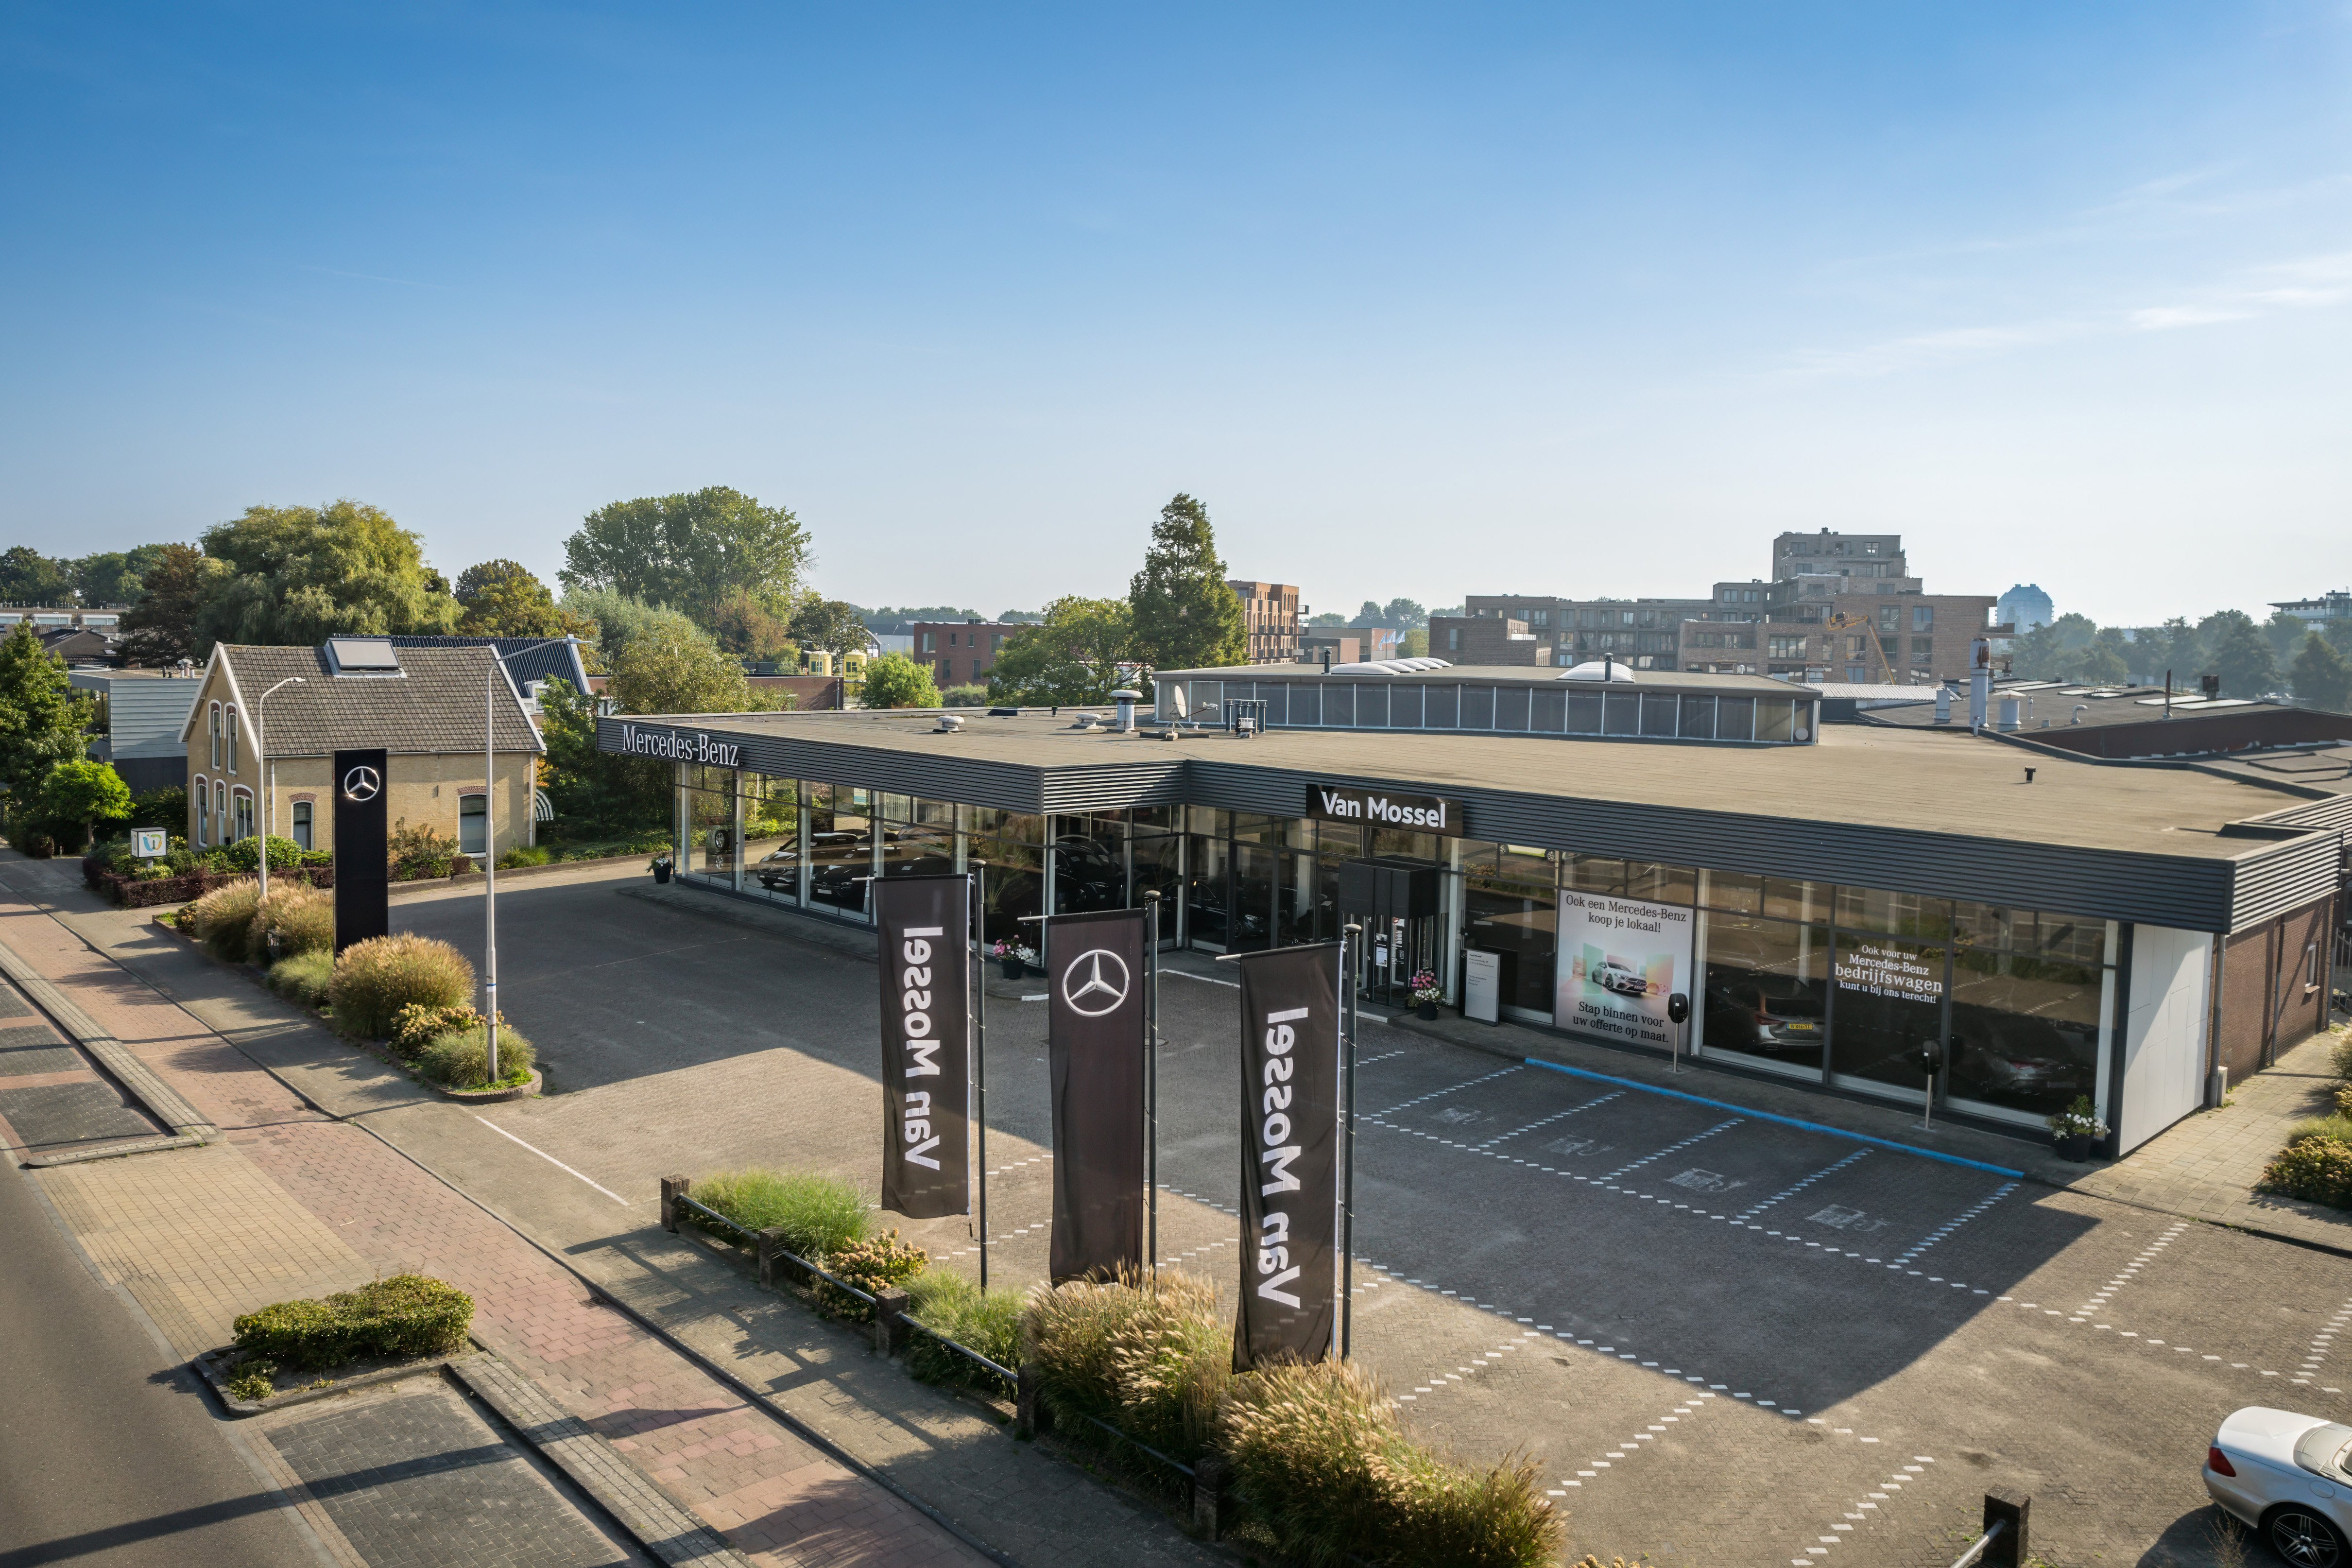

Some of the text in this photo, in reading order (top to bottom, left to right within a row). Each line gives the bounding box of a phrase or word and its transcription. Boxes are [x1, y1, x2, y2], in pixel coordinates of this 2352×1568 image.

[622, 724, 738, 766] Mercedes-Benz
[1321, 791, 1445, 828] Van Mossel
[1566, 895, 1686, 922] Ook een Mercedes-Benz
[1588, 912, 1661, 932] koop je lokaal!
[1849, 953, 1929, 976] Mercedes-Benz
[1862, 945, 1917, 961] Ook voor uw
[1835, 963, 1943, 992] bedrijfswagen
[1839, 980, 1860, 991] kunt
[1871, 984, 1881, 996] bij
[1884, 989, 1899, 997] ons
[1902, 990, 1936, 1003] terecht!
[1579, 1001, 1664, 1027] Stap binnen voor
[1573, 1016, 1668, 1042] uw offerte op maat.
